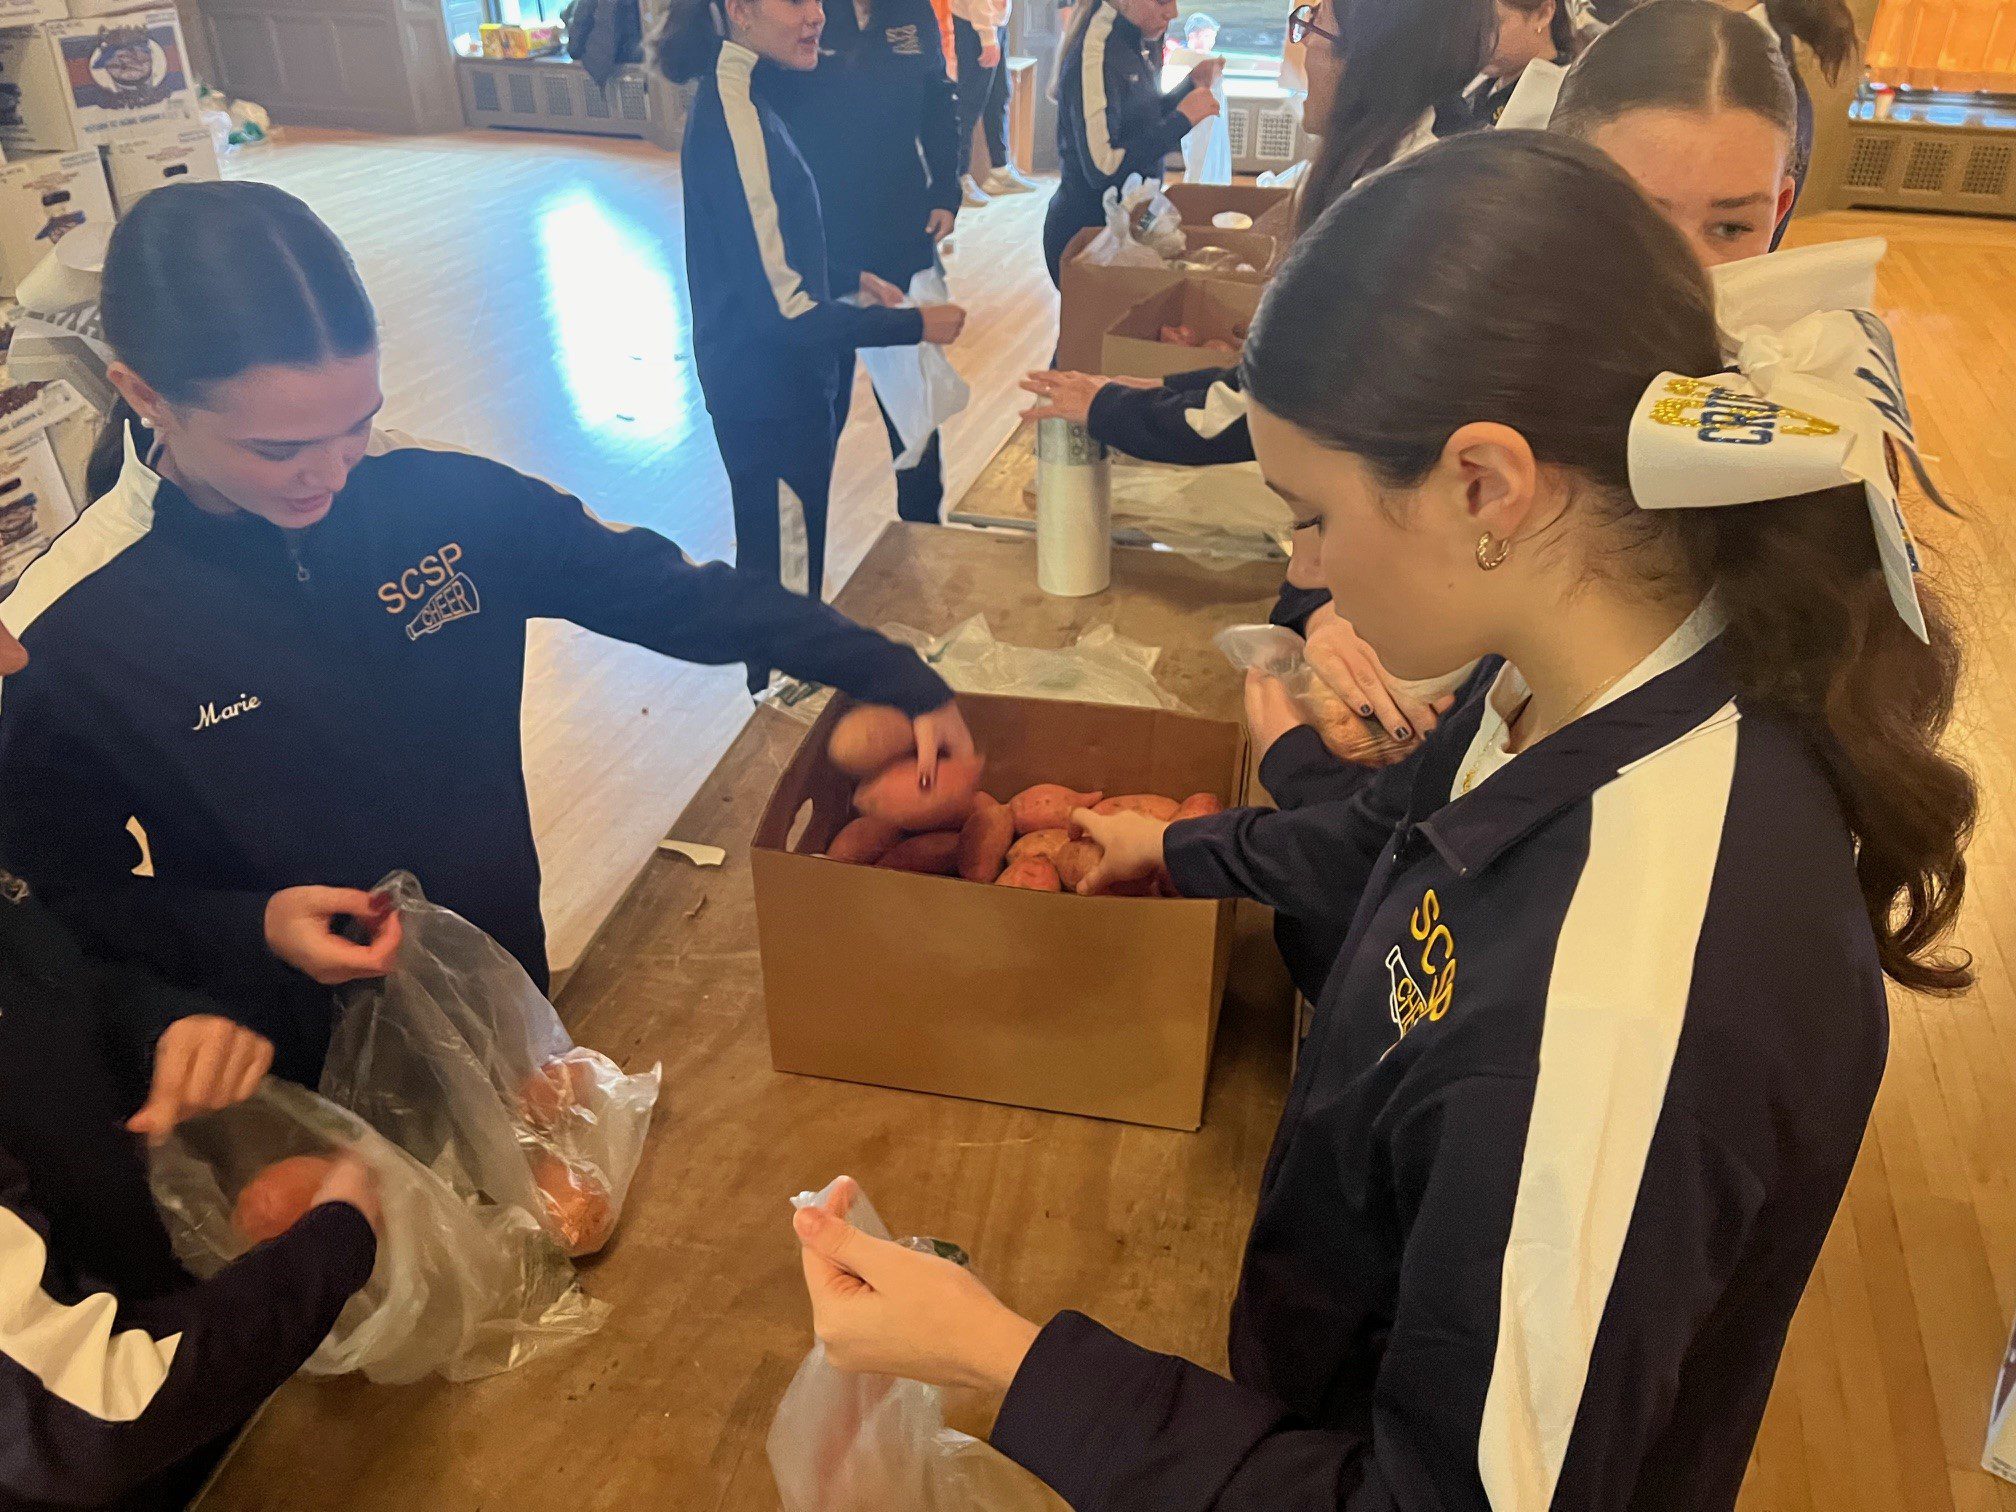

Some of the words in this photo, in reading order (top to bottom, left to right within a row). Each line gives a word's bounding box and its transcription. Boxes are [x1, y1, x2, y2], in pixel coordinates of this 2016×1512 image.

[377, 543, 462, 614] SCSP
[421, 580, 474, 627] CHEER
[192, 693, 262, 731] Marie
